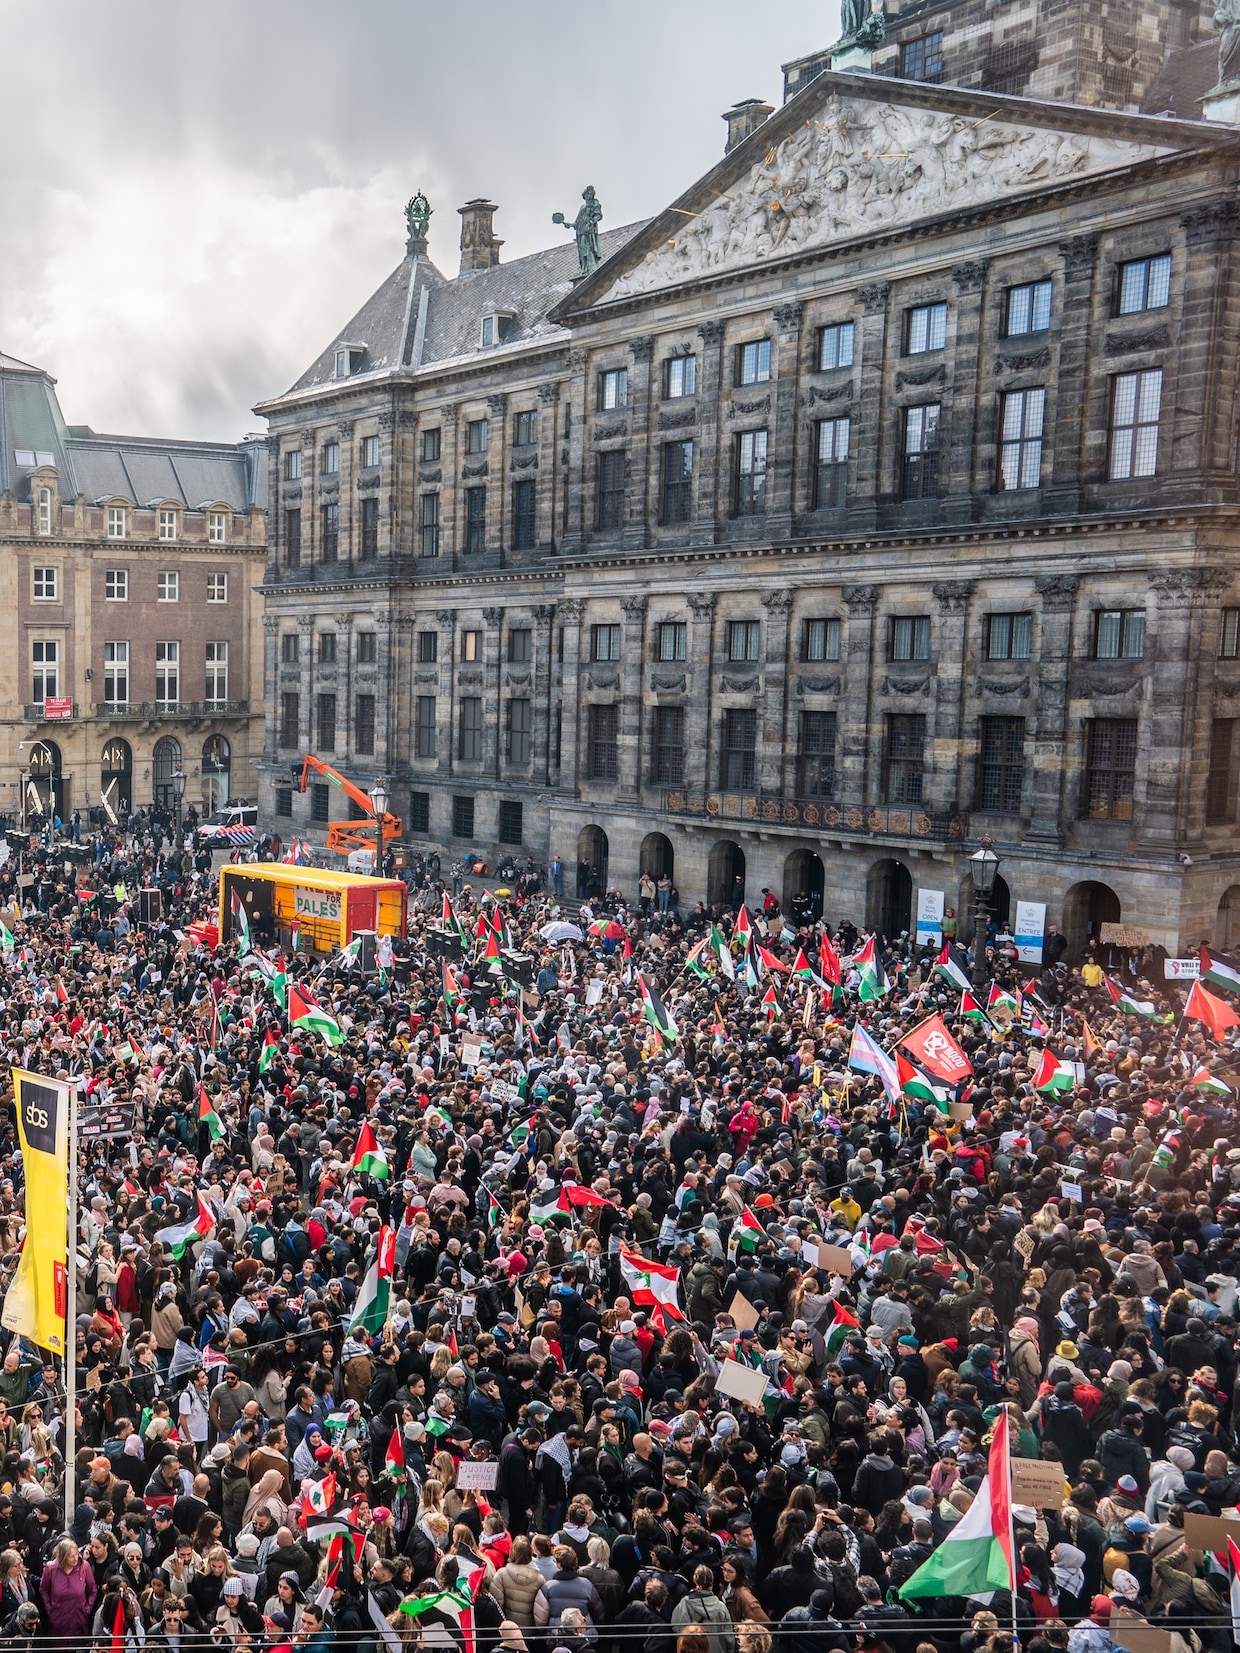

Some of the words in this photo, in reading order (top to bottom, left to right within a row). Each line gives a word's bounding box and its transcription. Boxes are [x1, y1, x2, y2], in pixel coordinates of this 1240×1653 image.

[326, 895, 341, 904] FOR
[297, 897, 341, 917] PALES
[943, 1046, 967, 1068] ROOD
[462, 1465, 496, 1474] JUSTICE
